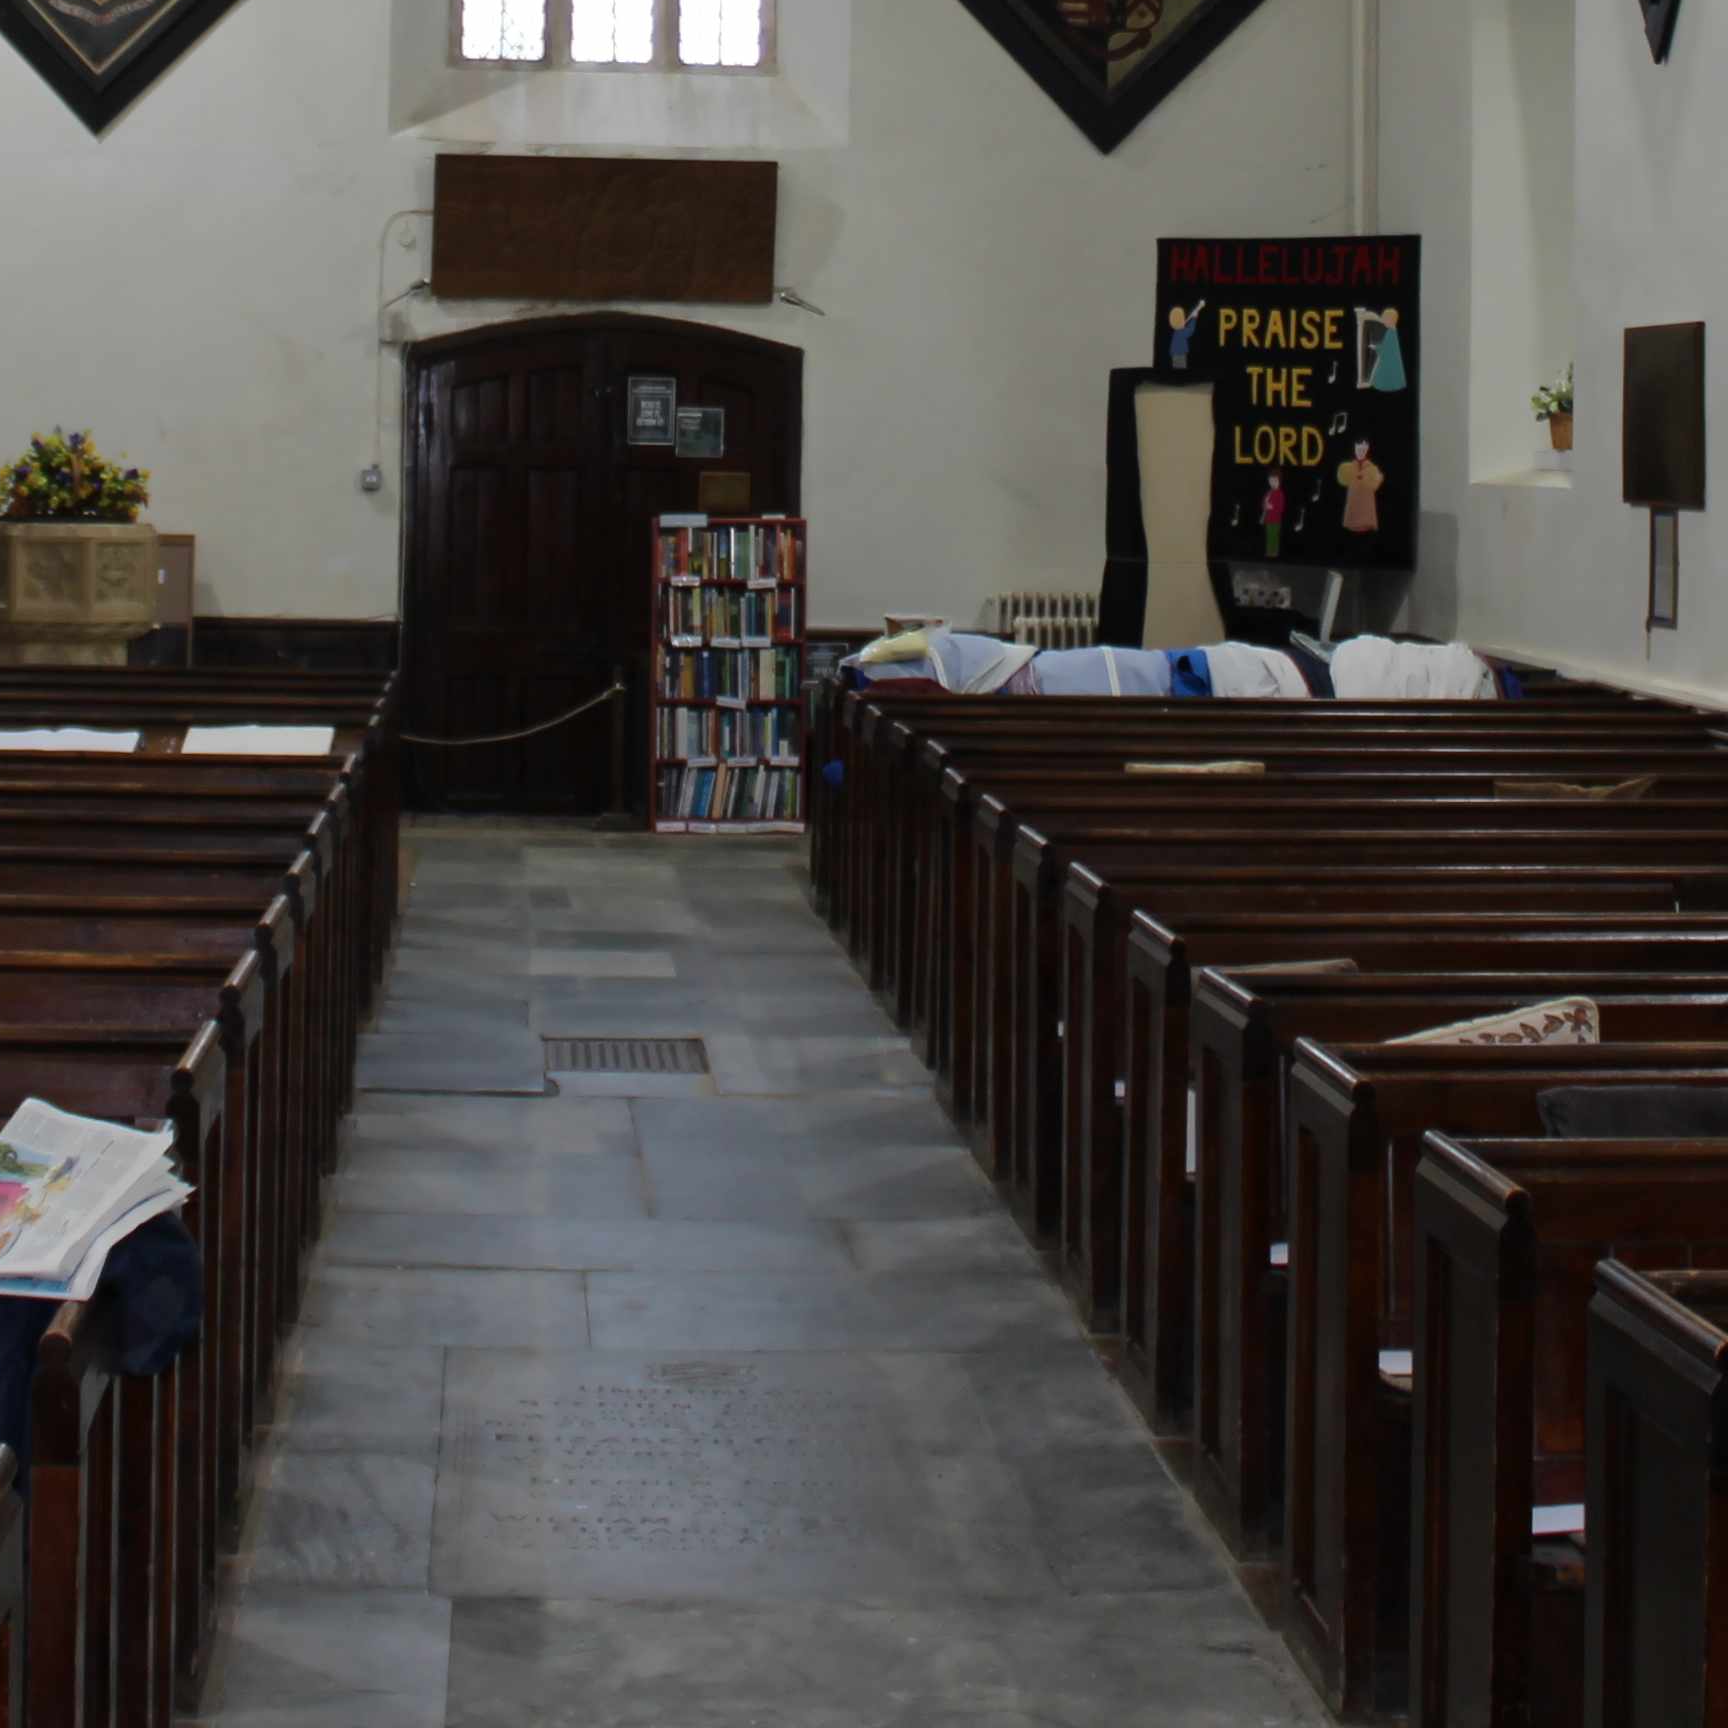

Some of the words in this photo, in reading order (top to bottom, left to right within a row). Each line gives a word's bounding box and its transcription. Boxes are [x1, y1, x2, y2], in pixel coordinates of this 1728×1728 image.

[1171, 245, 1400, 285] HALLELUJAH
[1218, 308, 1344, 350] PRAISE
[1246, 366, 1313, 409] THE
[1234, 425, 1325, 467] LORD
